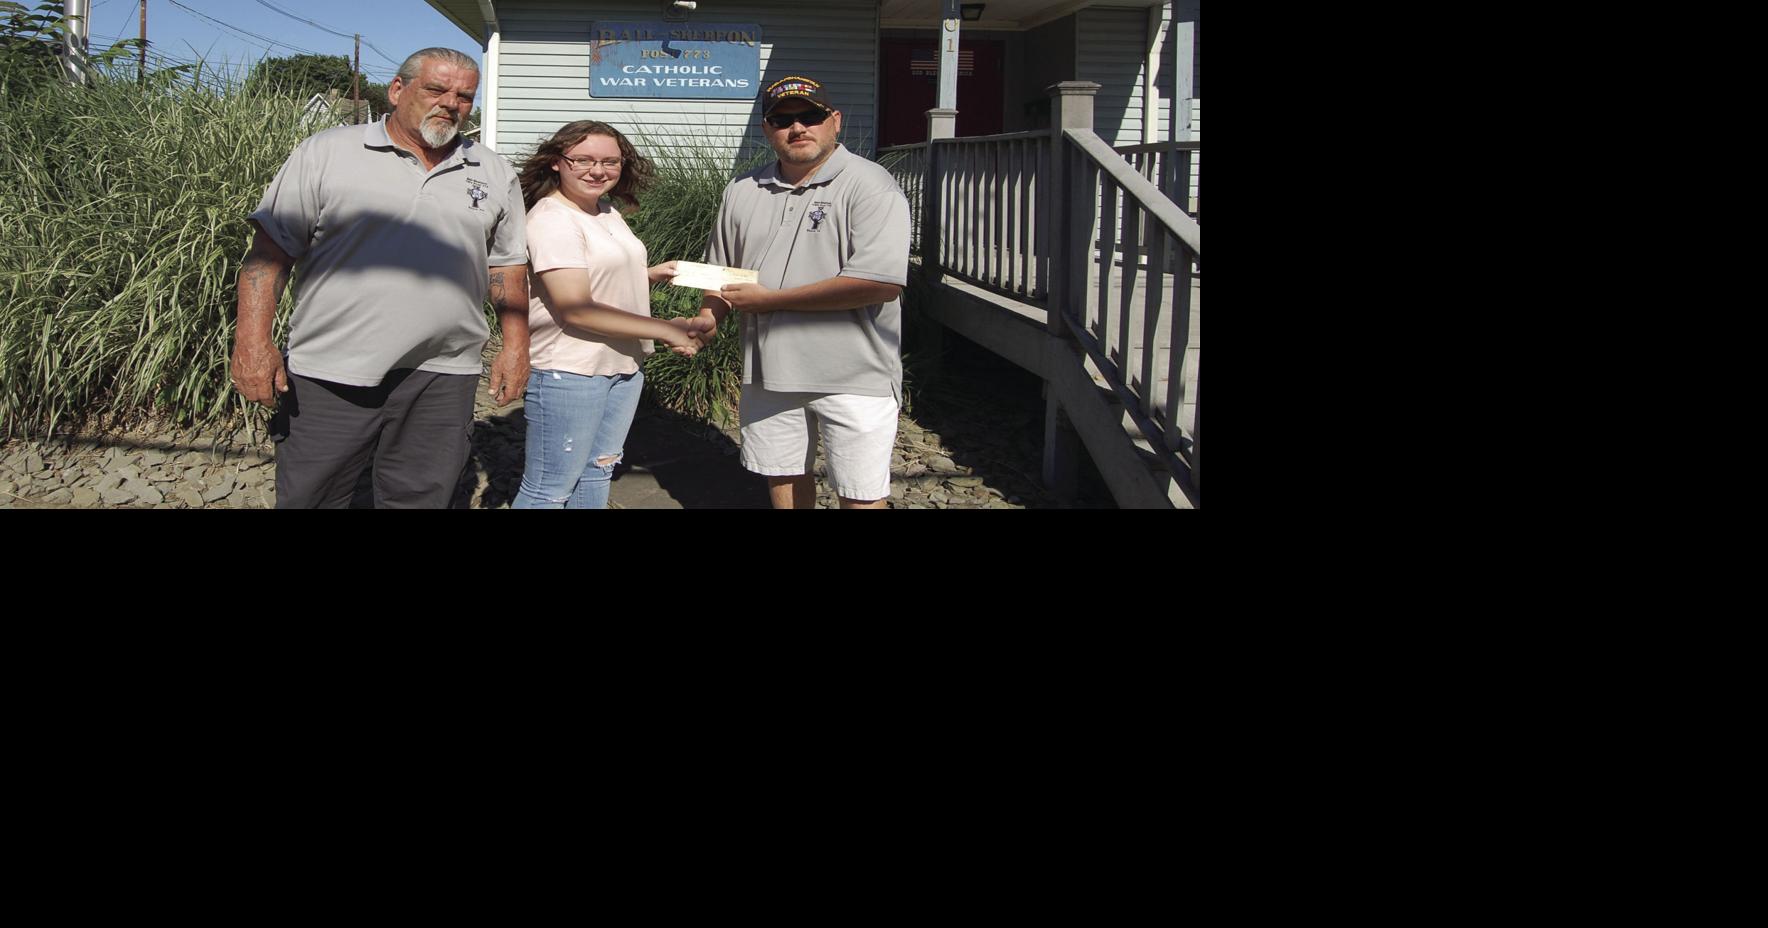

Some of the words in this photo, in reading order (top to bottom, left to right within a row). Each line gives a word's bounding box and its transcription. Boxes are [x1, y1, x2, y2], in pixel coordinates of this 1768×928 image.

[622, 65, 723, 75] CATHOLIC
[600, 77, 647, 87] WAR
[653, 78, 750, 88] VETERANS
[776, 90, 810, 99] VETERAN
